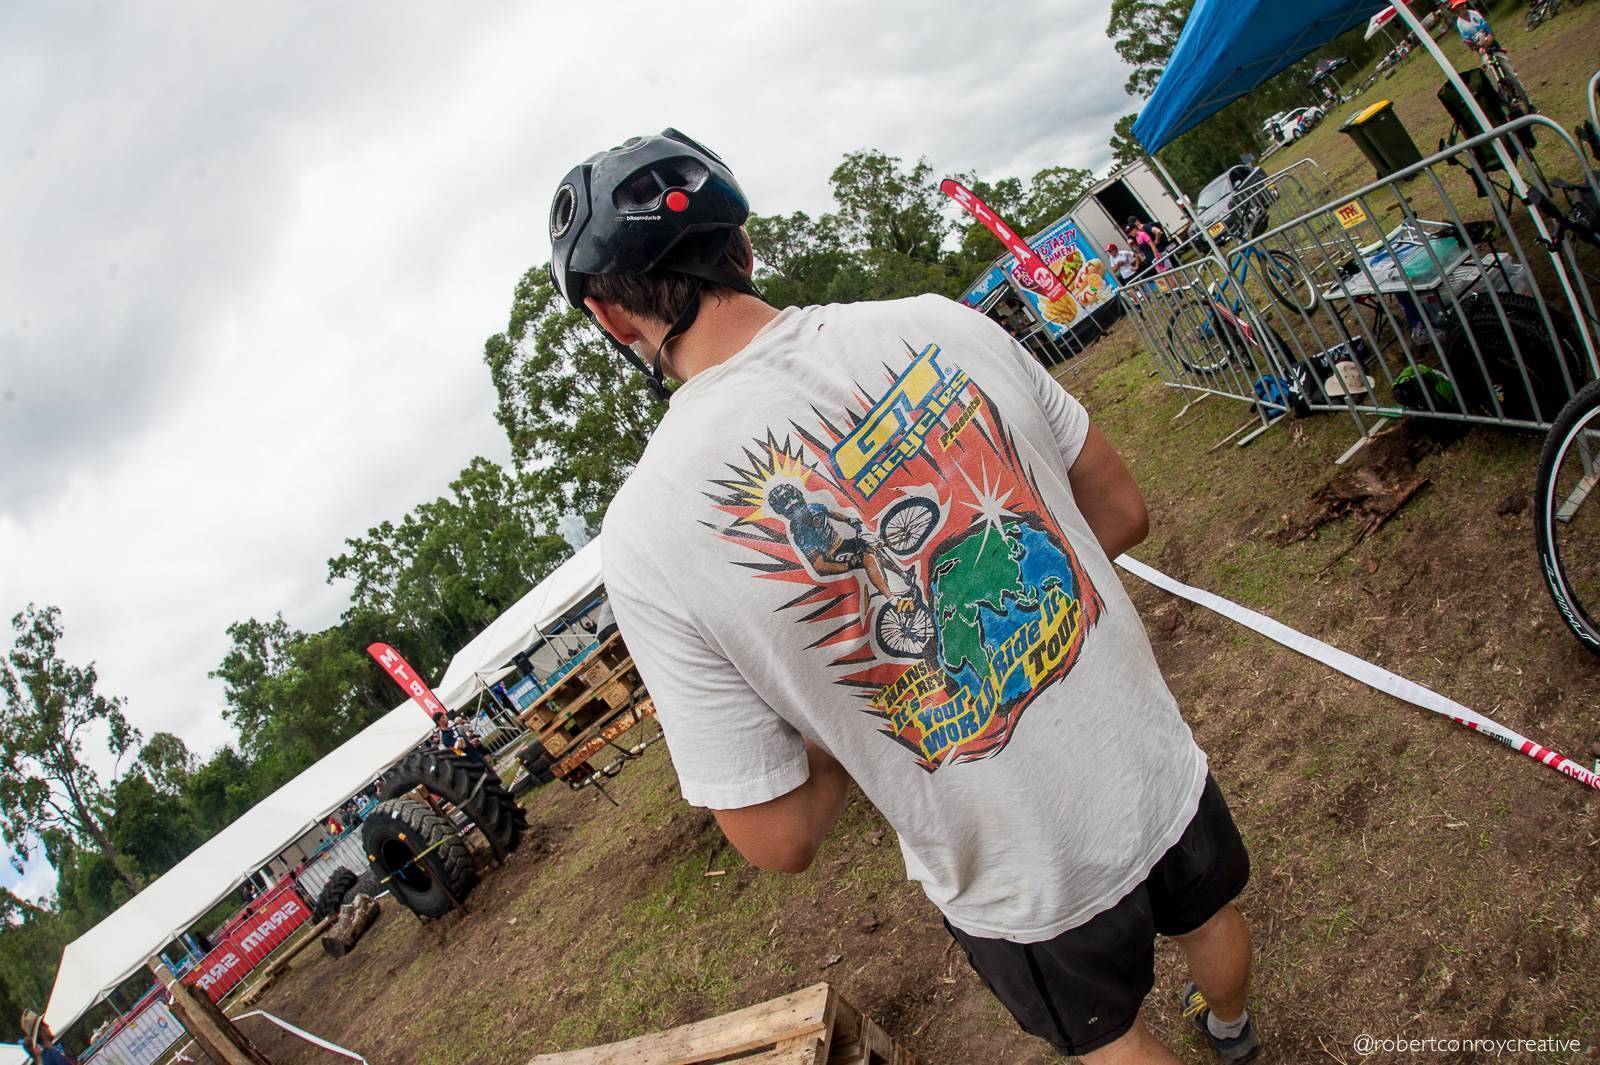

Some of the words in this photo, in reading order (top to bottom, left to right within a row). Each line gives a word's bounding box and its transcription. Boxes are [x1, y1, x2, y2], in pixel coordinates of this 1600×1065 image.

[1046, 228, 1077, 251] TASTY
[831, 343, 943, 480] GT
[855, 370, 970, 499] Bicycles
[380, 648, 439, 713] MTBA
[915, 669, 945, 698] REY
